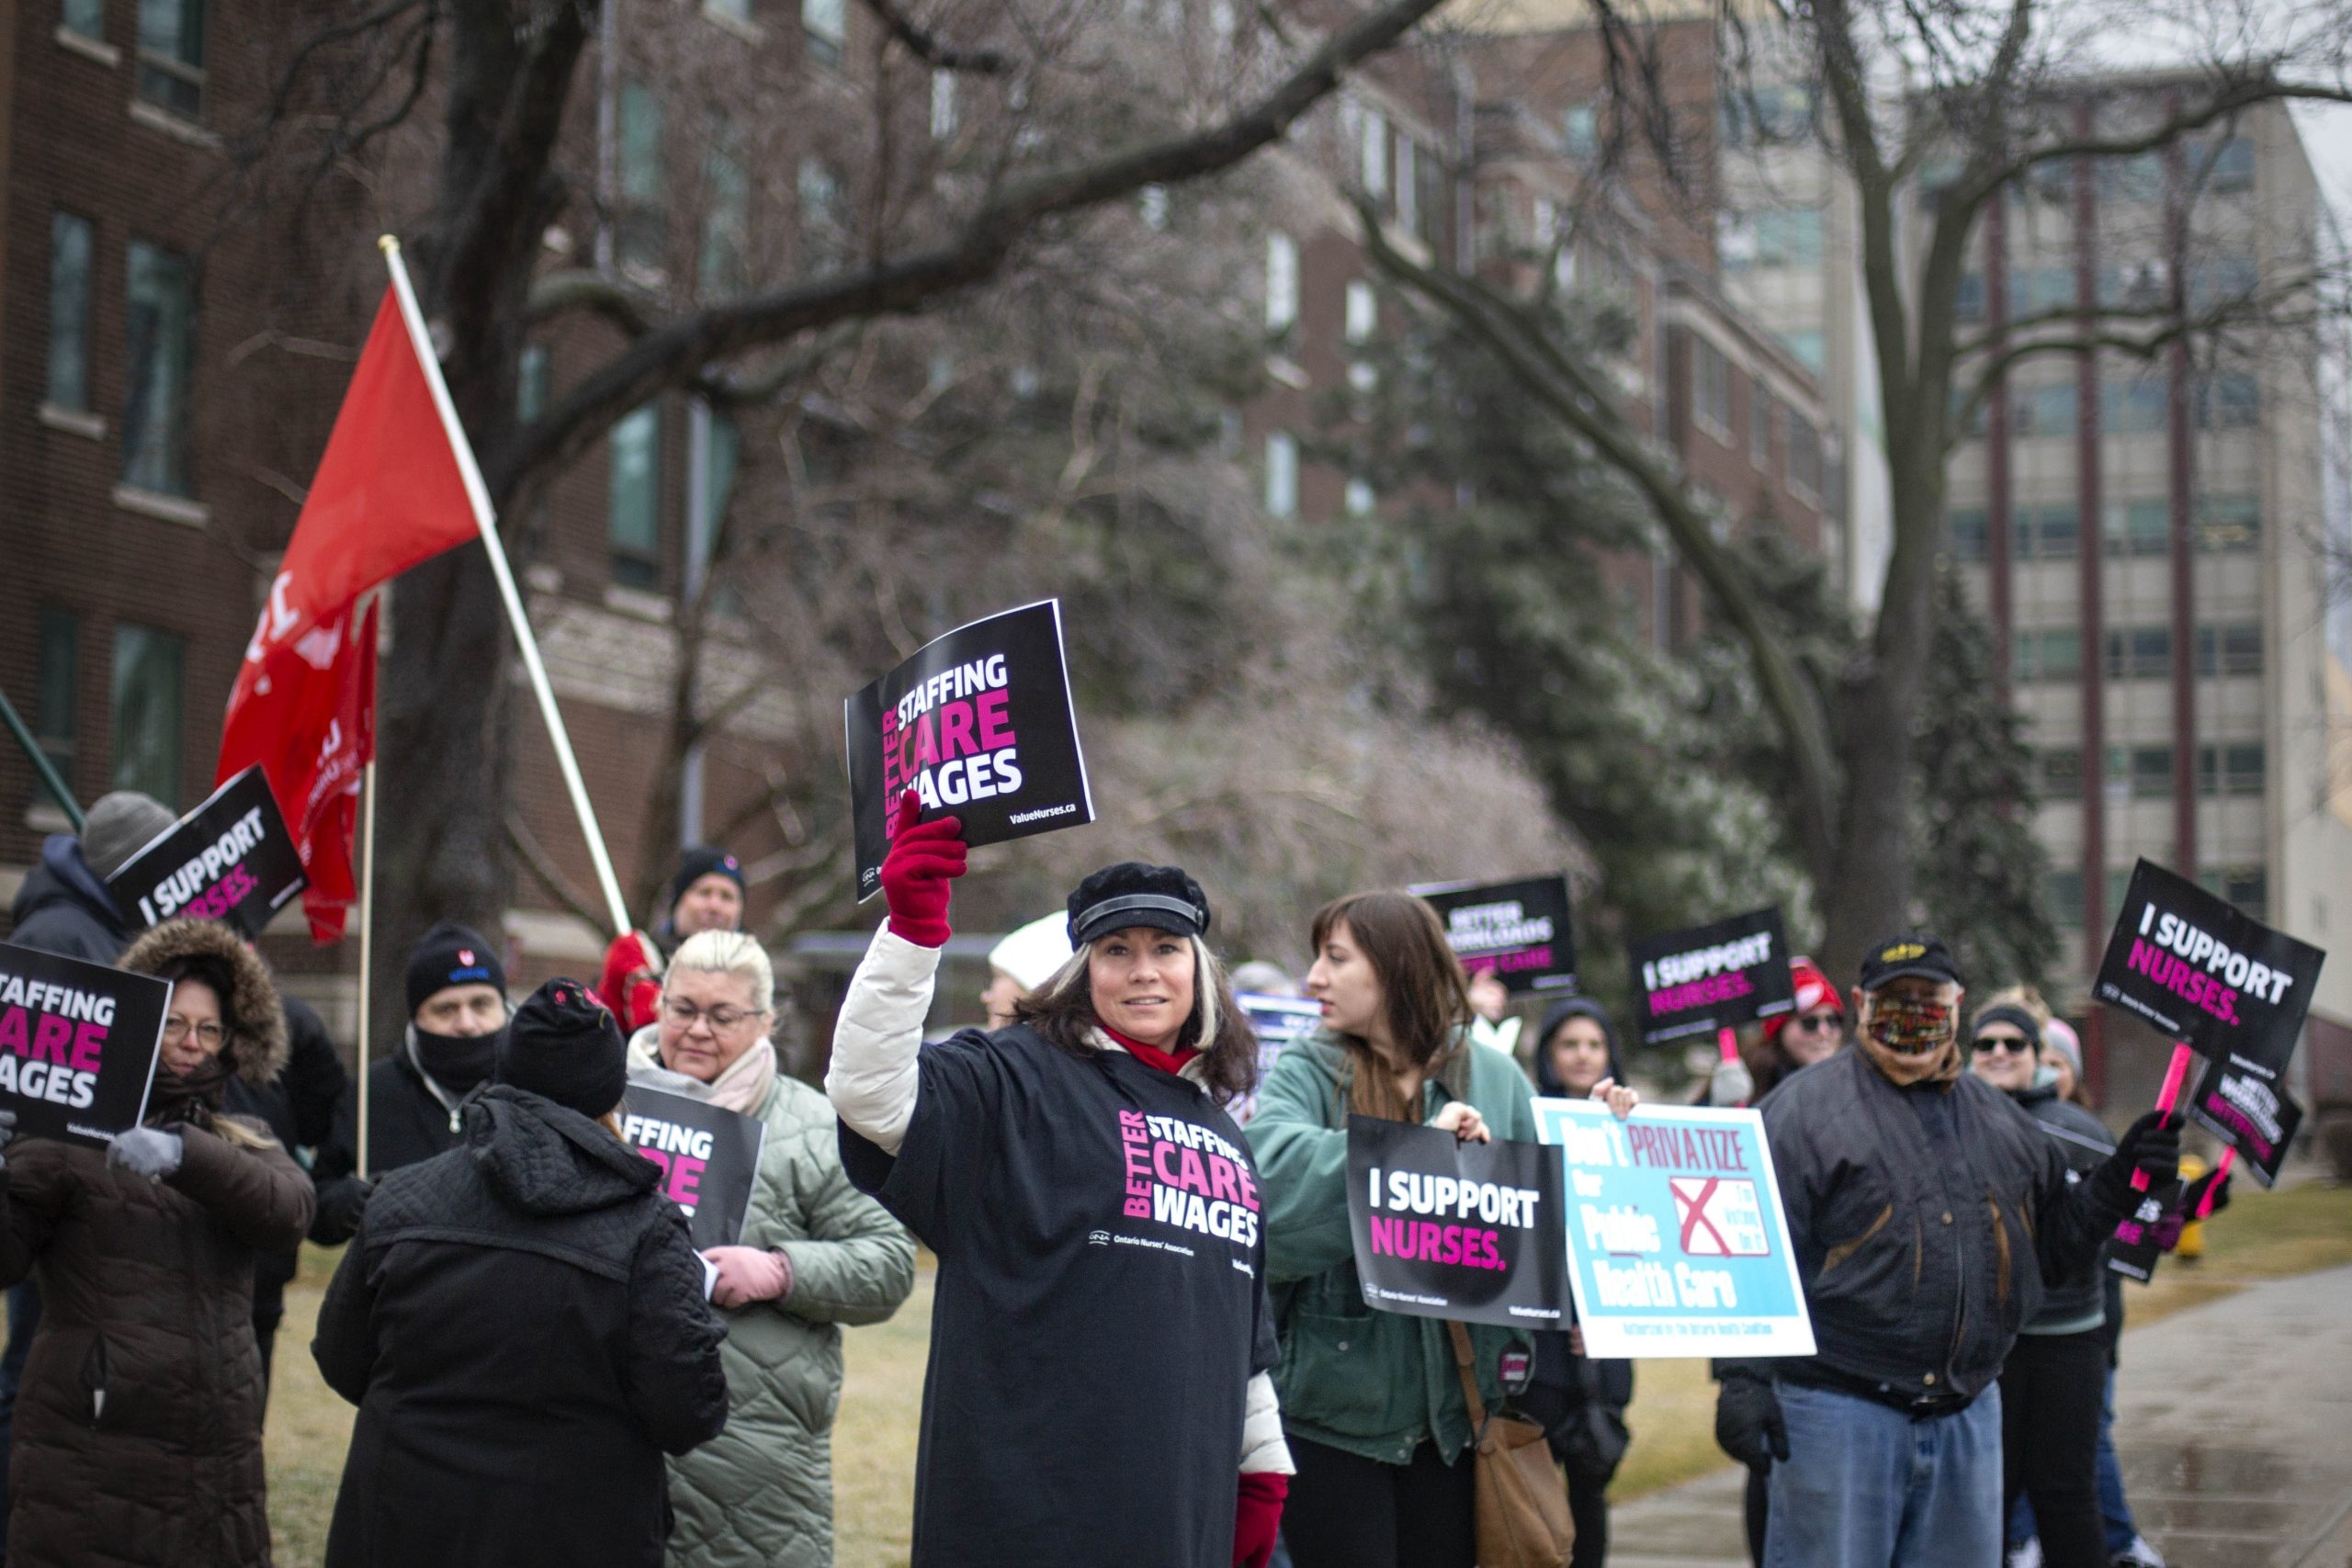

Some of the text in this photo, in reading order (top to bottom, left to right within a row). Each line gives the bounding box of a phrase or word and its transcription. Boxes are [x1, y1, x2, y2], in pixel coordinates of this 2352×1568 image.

[898, 654, 1008, 731] STAFFING
[899, 689, 1016, 784] CARE
[882, 704, 900, 840] BETTER
[1010, 803, 1076, 825] ValueNurses.ca
[138, 896, 158, 928] I
[153, 805, 266, 918] SUPPORT
[179, 863, 259, 919] RSES.
[1642, 931, 1773, 992] I SUPPORT
[2127, 937, 2241, 1027] NURSES.
[2138, 902, 2294, 1006] I SUPPORT
[0, 973, 117, 1028] TAFFING
[1649, 969, 1755, 1017] NURSES.
[0, 1005, 108, 1074] ARE
[0, 1054, 97, 1110] AGES
[1118, 1109, 1153, 1219] BETTER
[1559, 1115, 1749, 1172] Don't PRIVATIZE
[1153, 1140, 1261, 1213] CARE
[1370, 1168, 1540, 1229] I SUPPORT
[1114, 1235, 1140, 1246] Ontario
[1164, 1243, 1194, 1257] Association
[1153, 1183, 1259, 1248] WAGES
[1370, 1215, 1507, 1272] NURSES.
[1578, 1203, 1662, 1252] Public
[1591, 1259, 1738, 1308] Health Care
